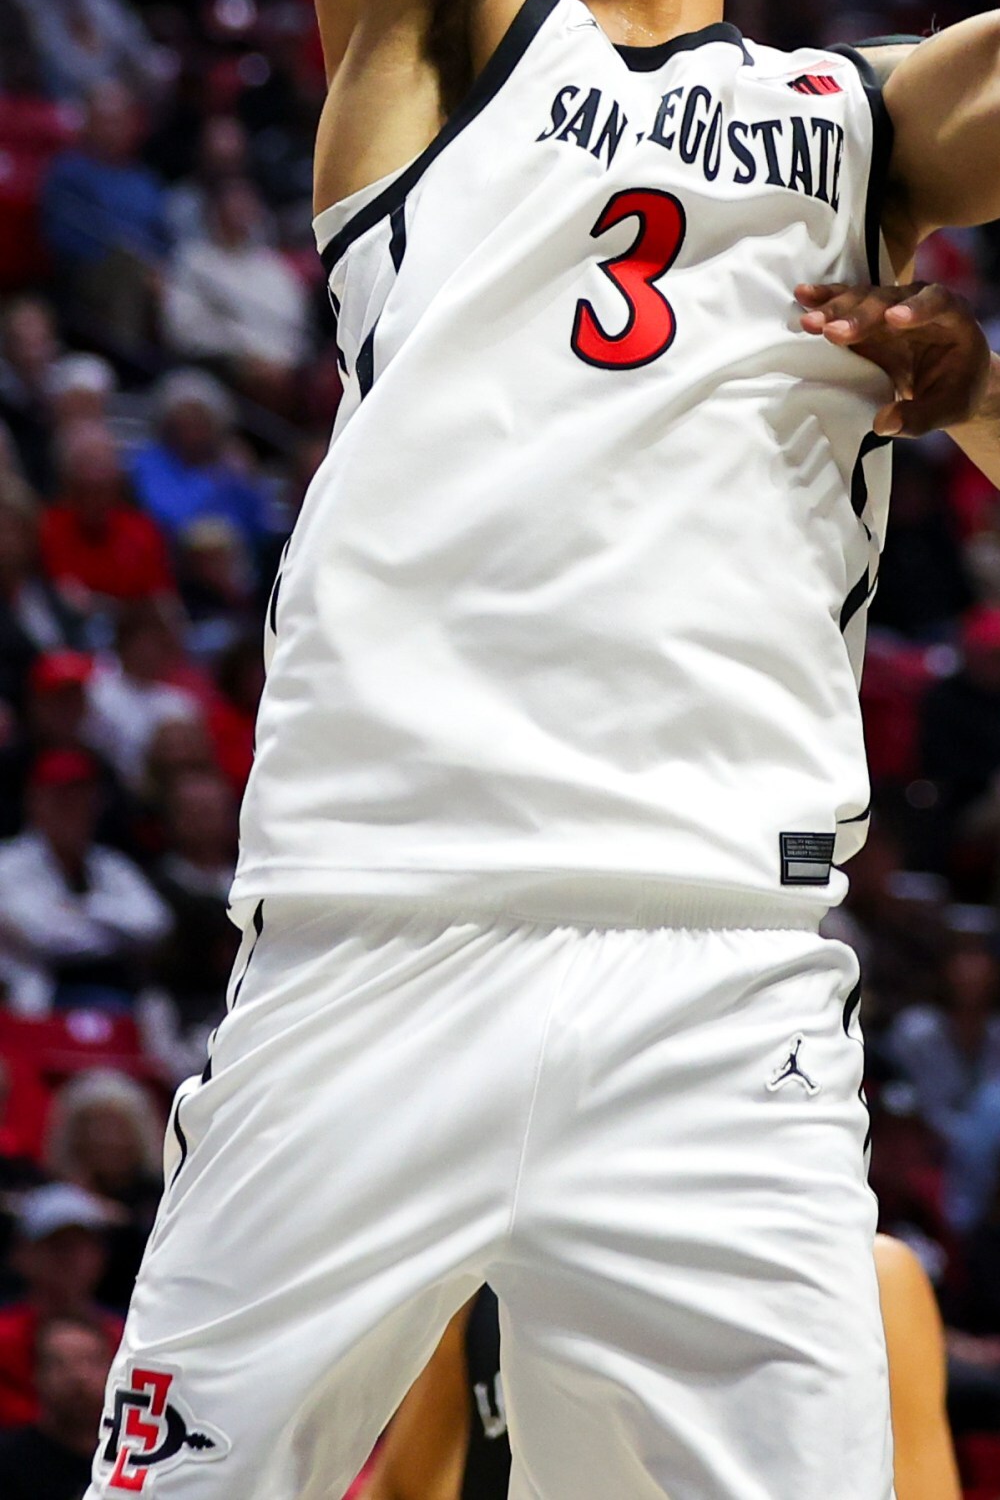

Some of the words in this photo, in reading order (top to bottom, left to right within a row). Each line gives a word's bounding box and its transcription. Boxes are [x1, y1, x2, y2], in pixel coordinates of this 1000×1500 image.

[534, 84, 629, 171] SAN
[635, 84, 723, 182] EGO
[570, 186, 687, 371] 3
